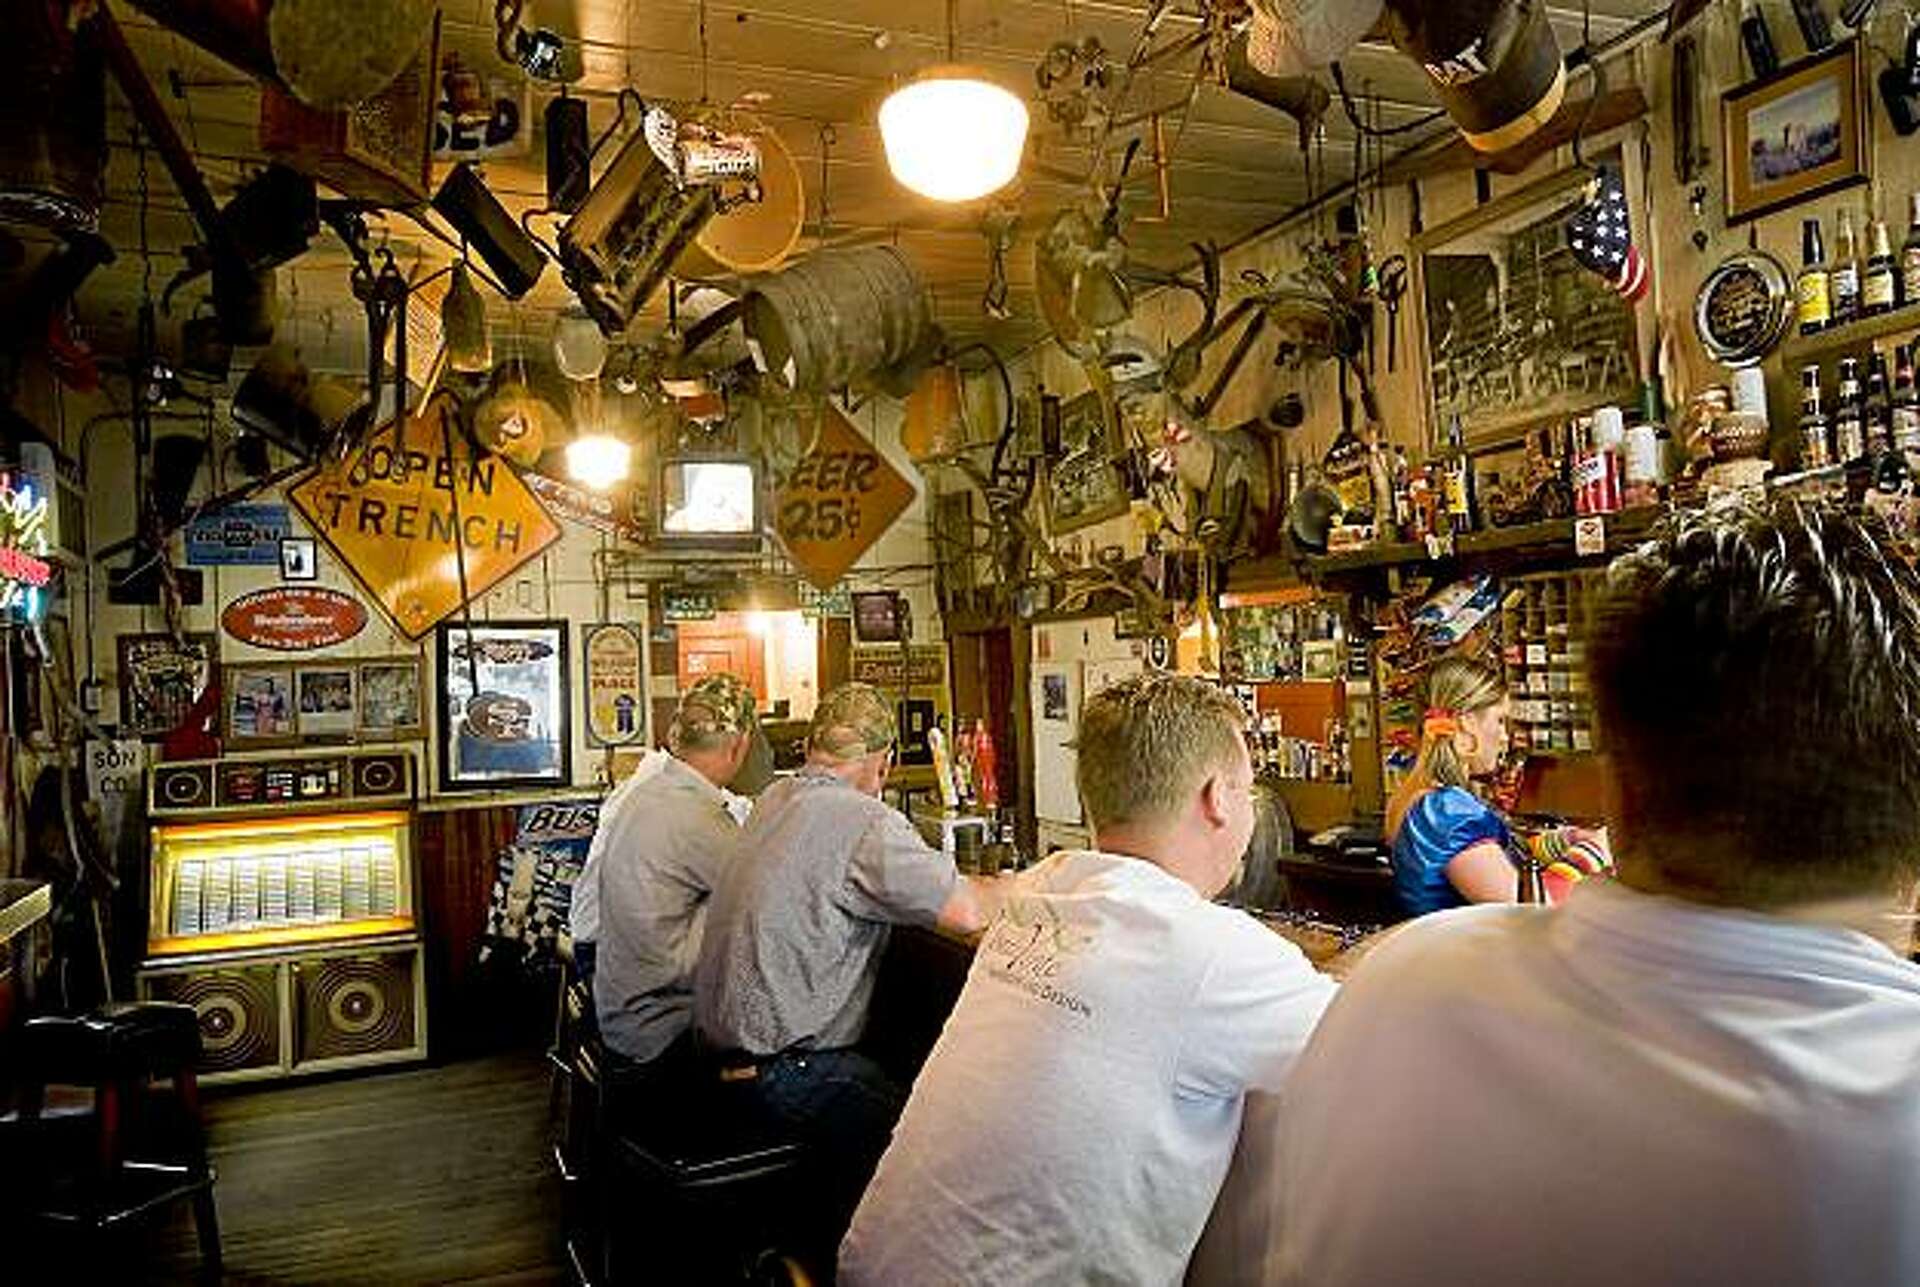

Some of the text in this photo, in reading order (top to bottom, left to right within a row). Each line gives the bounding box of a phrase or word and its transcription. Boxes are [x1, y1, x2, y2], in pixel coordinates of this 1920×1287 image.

[370, 445, 495, 496] OPEN
[775, 451, 880, 492] EER
[325, 491, 522, 554] TRENCH
[94, 750, 136, 768] SON
